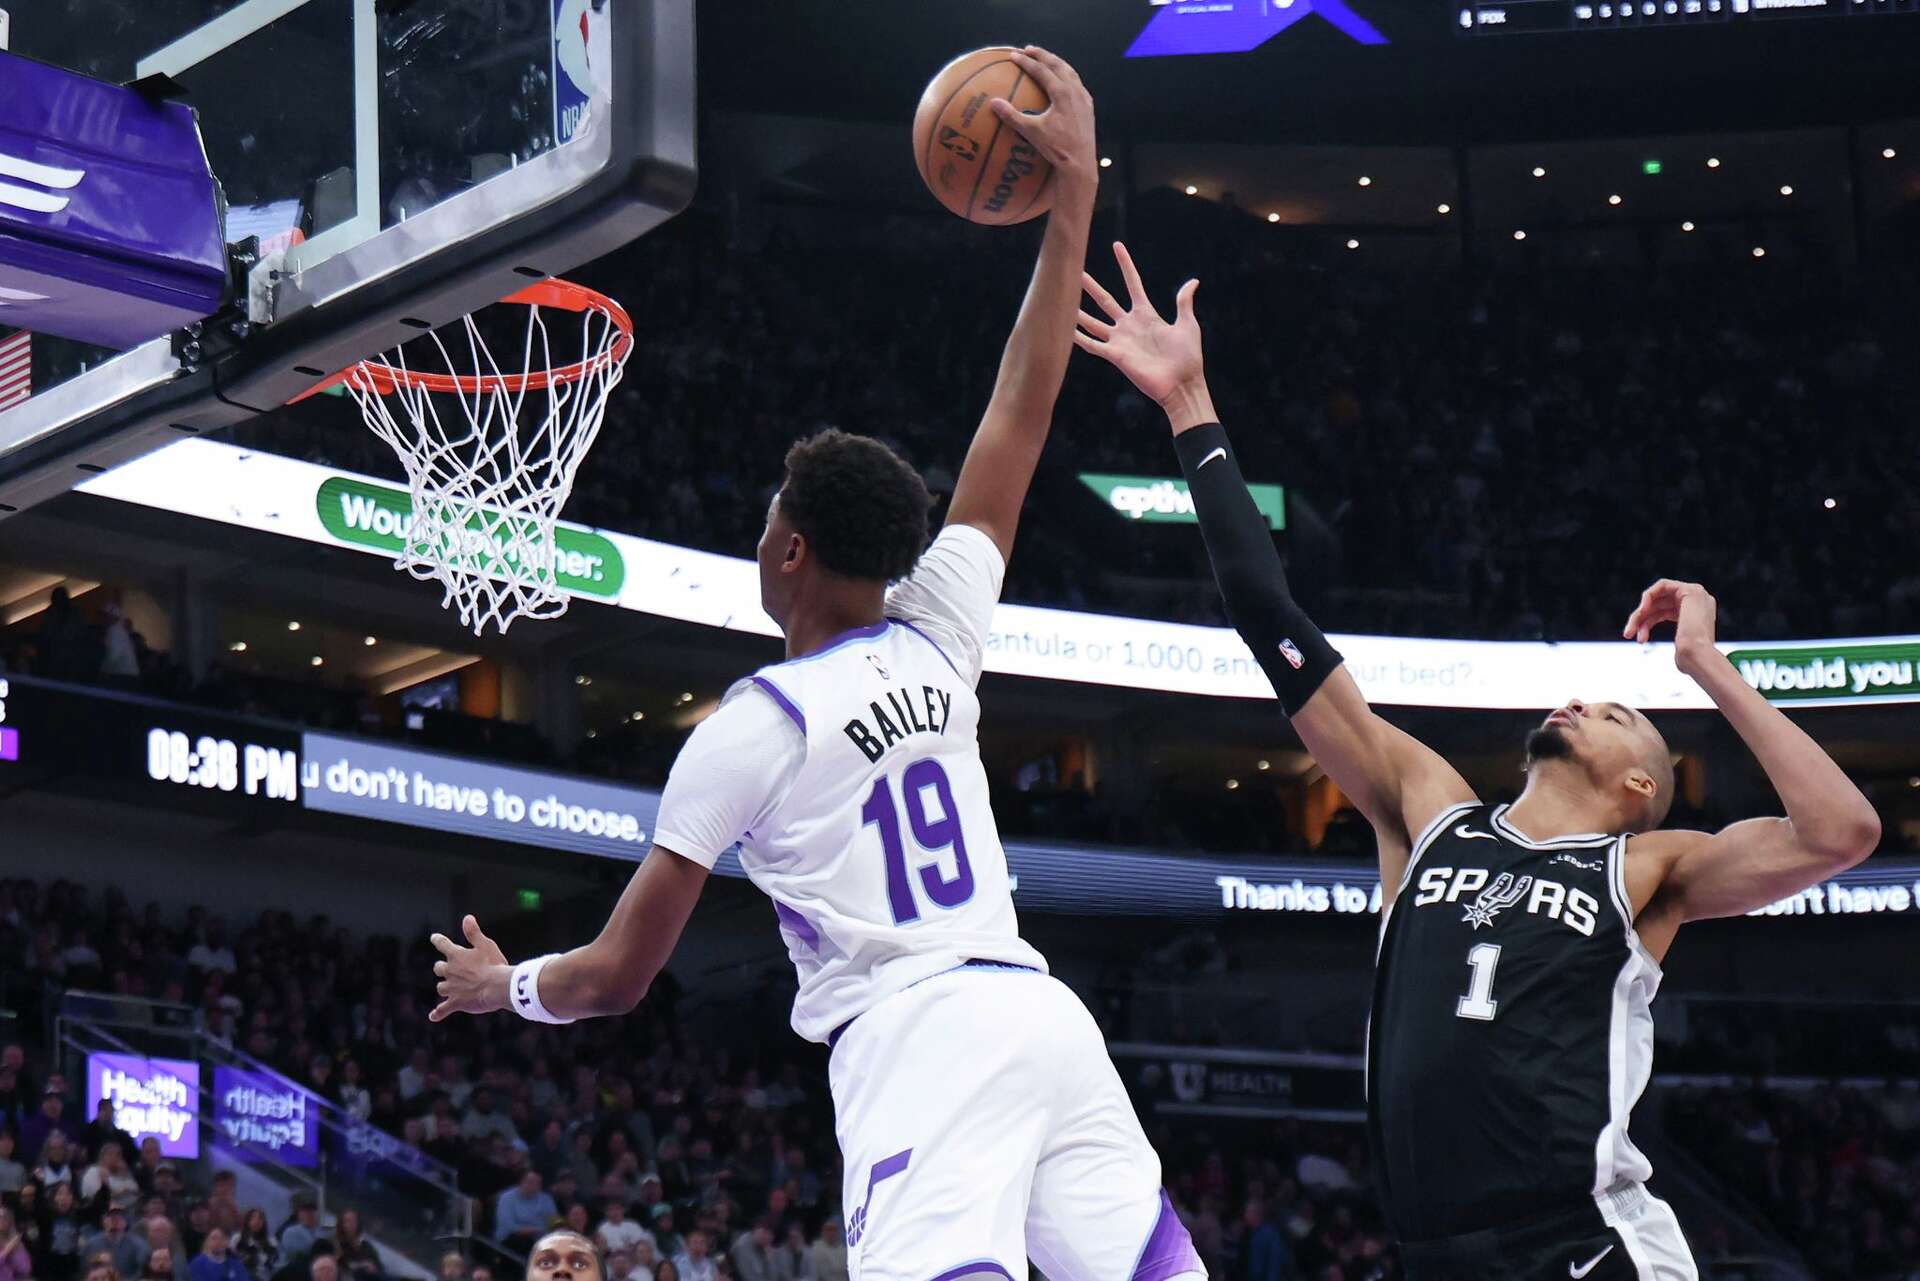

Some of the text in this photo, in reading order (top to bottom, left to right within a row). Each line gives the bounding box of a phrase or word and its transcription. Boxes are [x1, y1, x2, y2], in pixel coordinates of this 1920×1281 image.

[1477, 10, 1506, 24] FOX
[1110, 480, 1197, 519] aptiv
[1738, 656, 1846, 690] Would
[1849, 660, 1913, 693] you
[843, 685, 951, 764] BAILEY
[147, 728, 297, 802] 08:38 PM
[325, 758, 409, 804] don't
[413, 771, 489, 816] have
[492, 787, 526, 823] to
[529, 794, 647, 843] choose.
[860, 756, 977, 928] 19
[1215, 876, 1330, 912] Thanks
[1331, 882, 1367, 913] to
[1414, 866, 1600, 937] SPURS
[1827, 882, 1911, 914] have
[1455, 942, 1502, 1021] 1
[102, 1068, 187, 1107] Health
[1211, 1071, 1292, 1095] HEALTH
[113, 1101, 192, 1142] quity
